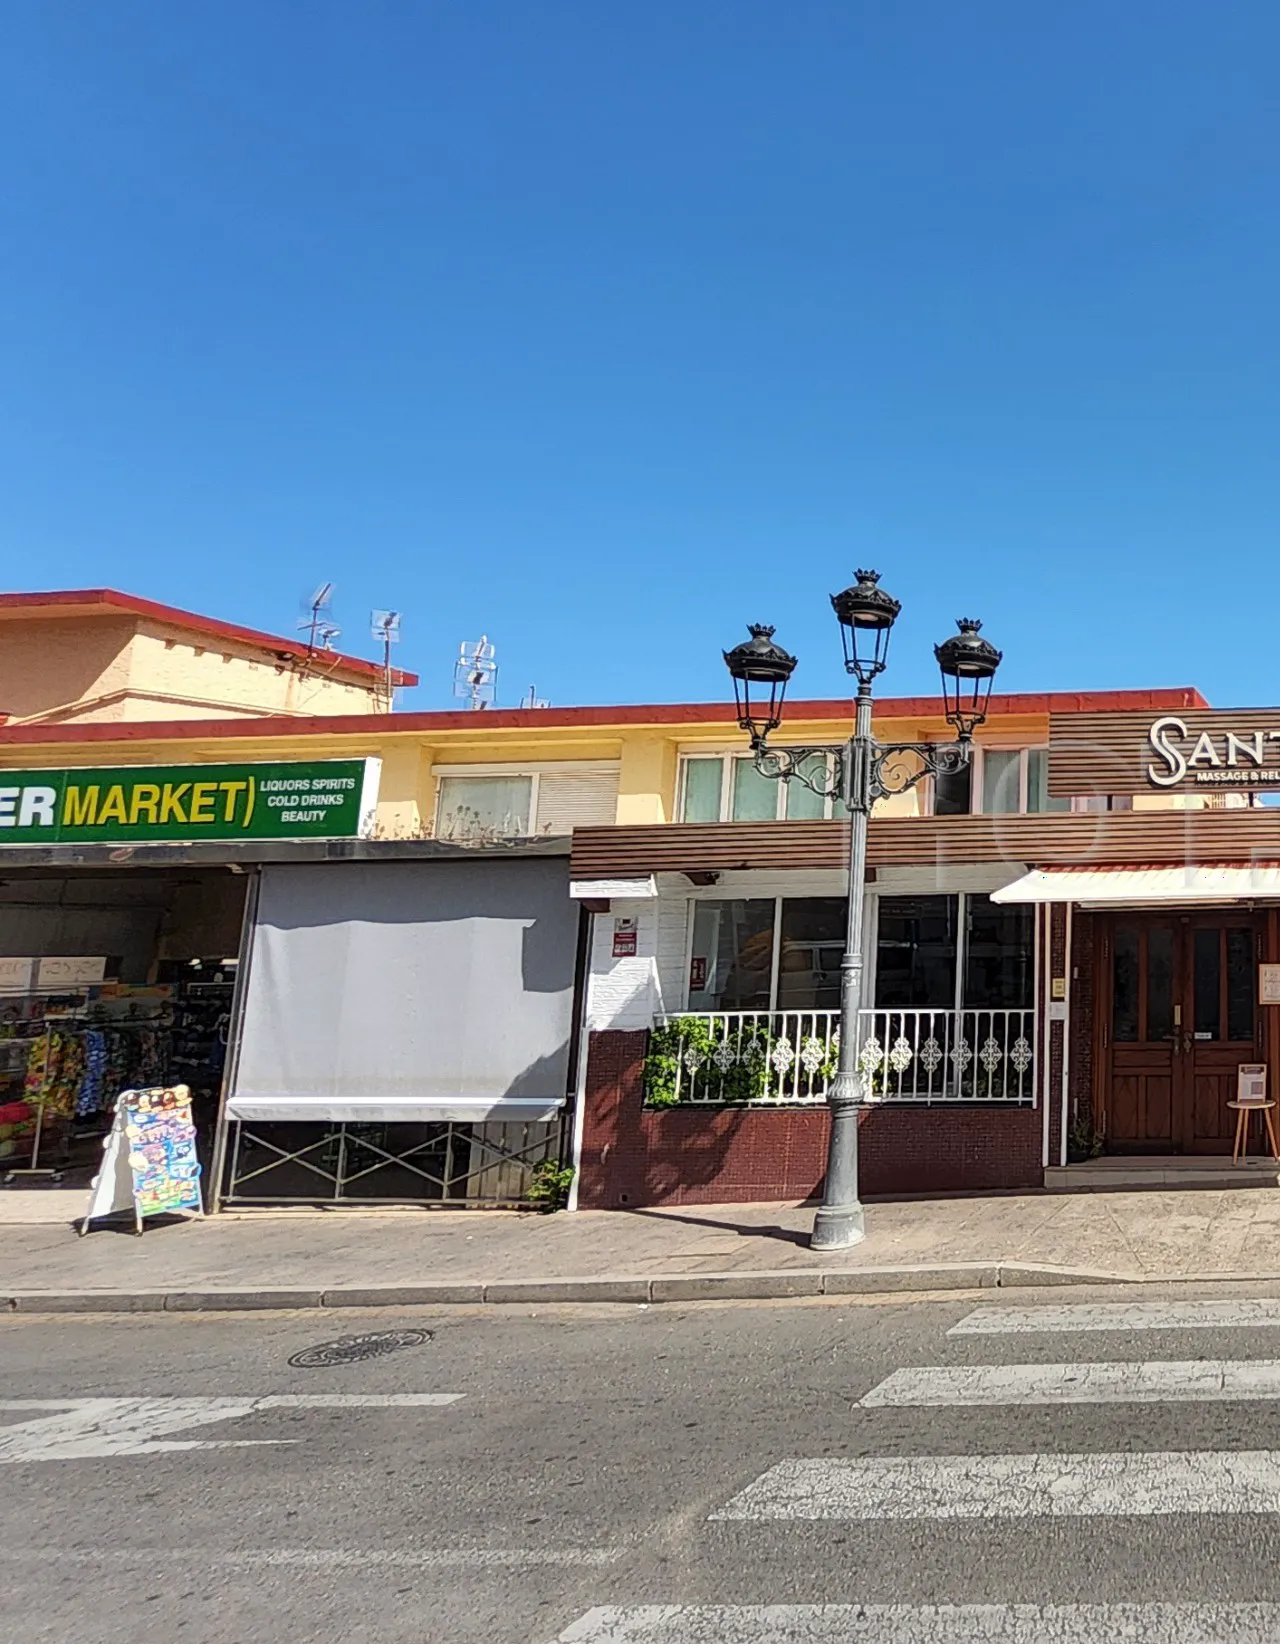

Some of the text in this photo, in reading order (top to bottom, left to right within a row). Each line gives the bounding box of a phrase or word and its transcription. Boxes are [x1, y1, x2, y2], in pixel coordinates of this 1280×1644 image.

[1197, 771, 1249, 781] MASSAGE
[1250, 771, 1259, 781] &
[260, 778, 356, 792] LIQUORS SPIRITS
[267, 794, 345, 807] COLD DRINKS
[281, 810, 327, 823] BEAUTY
